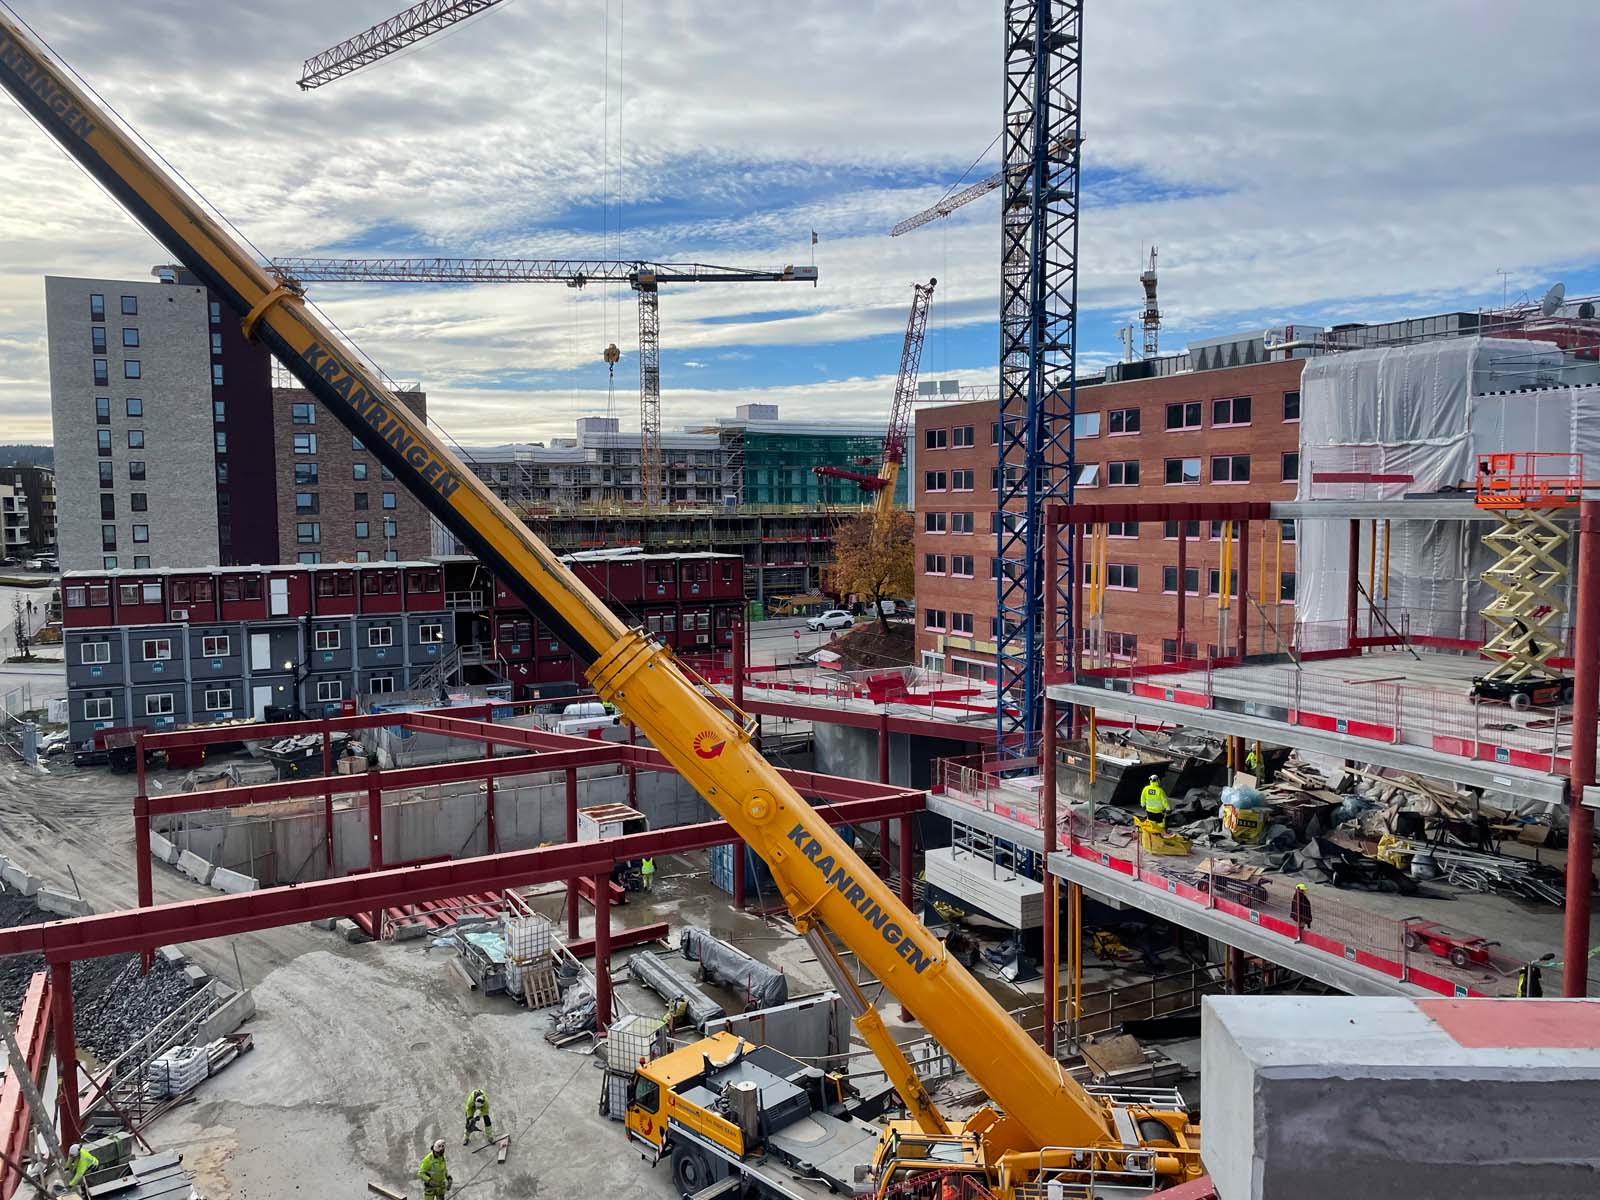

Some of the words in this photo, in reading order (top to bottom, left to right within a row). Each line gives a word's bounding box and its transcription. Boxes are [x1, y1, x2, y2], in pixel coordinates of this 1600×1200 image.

[0, 30, 96, 137] NRINGEN
[302, 342, 460, 498] KRANRINGEN
[787, 823, 932, 975] KRANRINGEN
